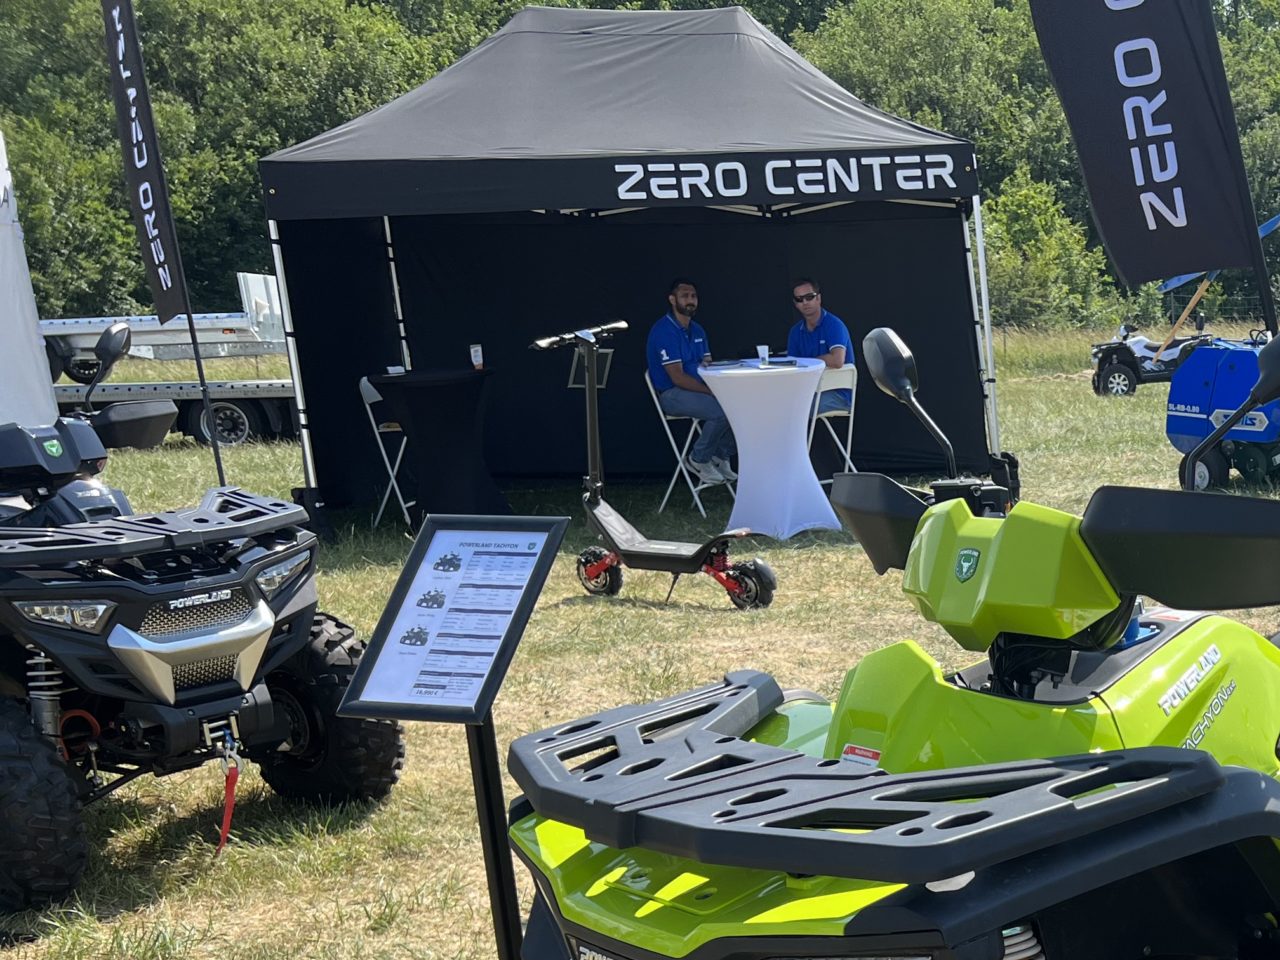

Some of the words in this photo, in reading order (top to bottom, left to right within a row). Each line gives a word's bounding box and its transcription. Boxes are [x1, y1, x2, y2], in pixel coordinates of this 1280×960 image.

[1114, 37, 1188, 230] ZERO
[614, 161, 748, 200] ZERO
[764, 154, 957, 195] CENTER
[139, 181, 173, 291] ZERO
[660, 349, 669, 361] 1
[168, 589, 232, 610] POWERLAND
[1158, 643, 1222, 718] POWERLAND
[1182, 685, 1229, 750] ACHYON
